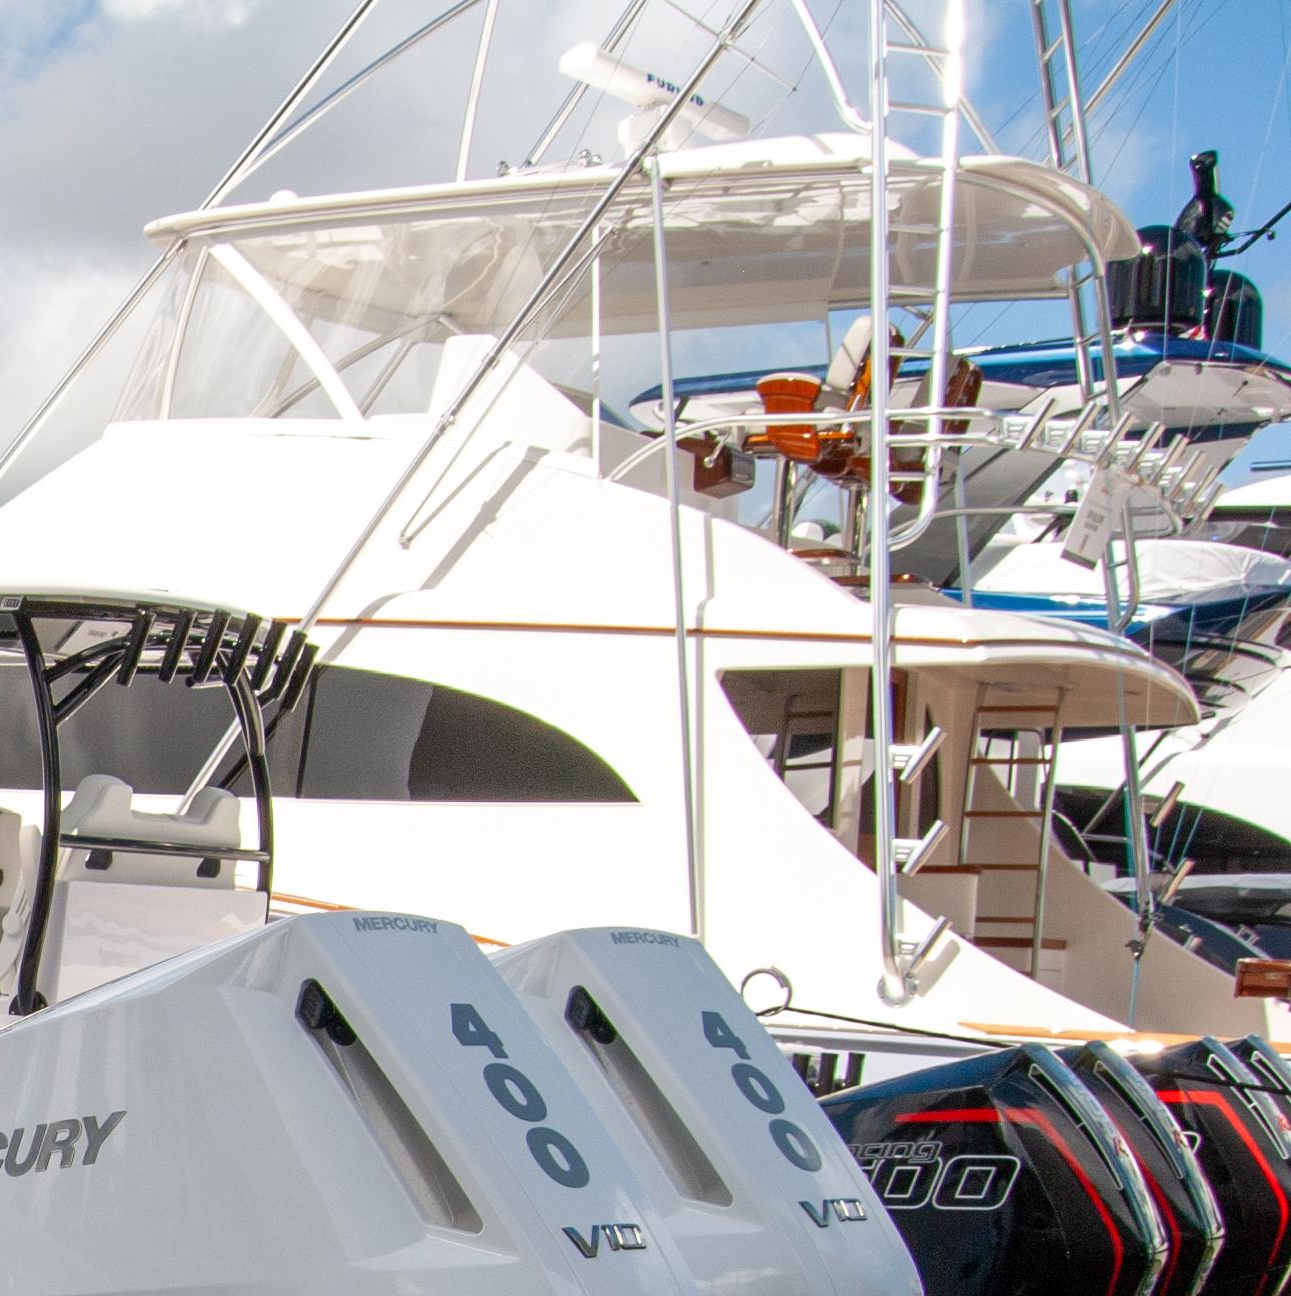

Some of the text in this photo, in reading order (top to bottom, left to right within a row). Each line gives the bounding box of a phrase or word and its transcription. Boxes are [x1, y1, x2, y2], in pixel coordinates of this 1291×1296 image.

[646, 73, 704, 107] FURO
[352, 917, 439, 935] MERCURY
[610, 932, 681, 948] MERCURY
[450, 1003, 590, 1189] 400
[700, 1010, 823, 1173] 400
[860, 1155, 1021, 1211] 00
[797, 1199, 867, 1228] V10
[562, 1223, 648, 1259] V10
